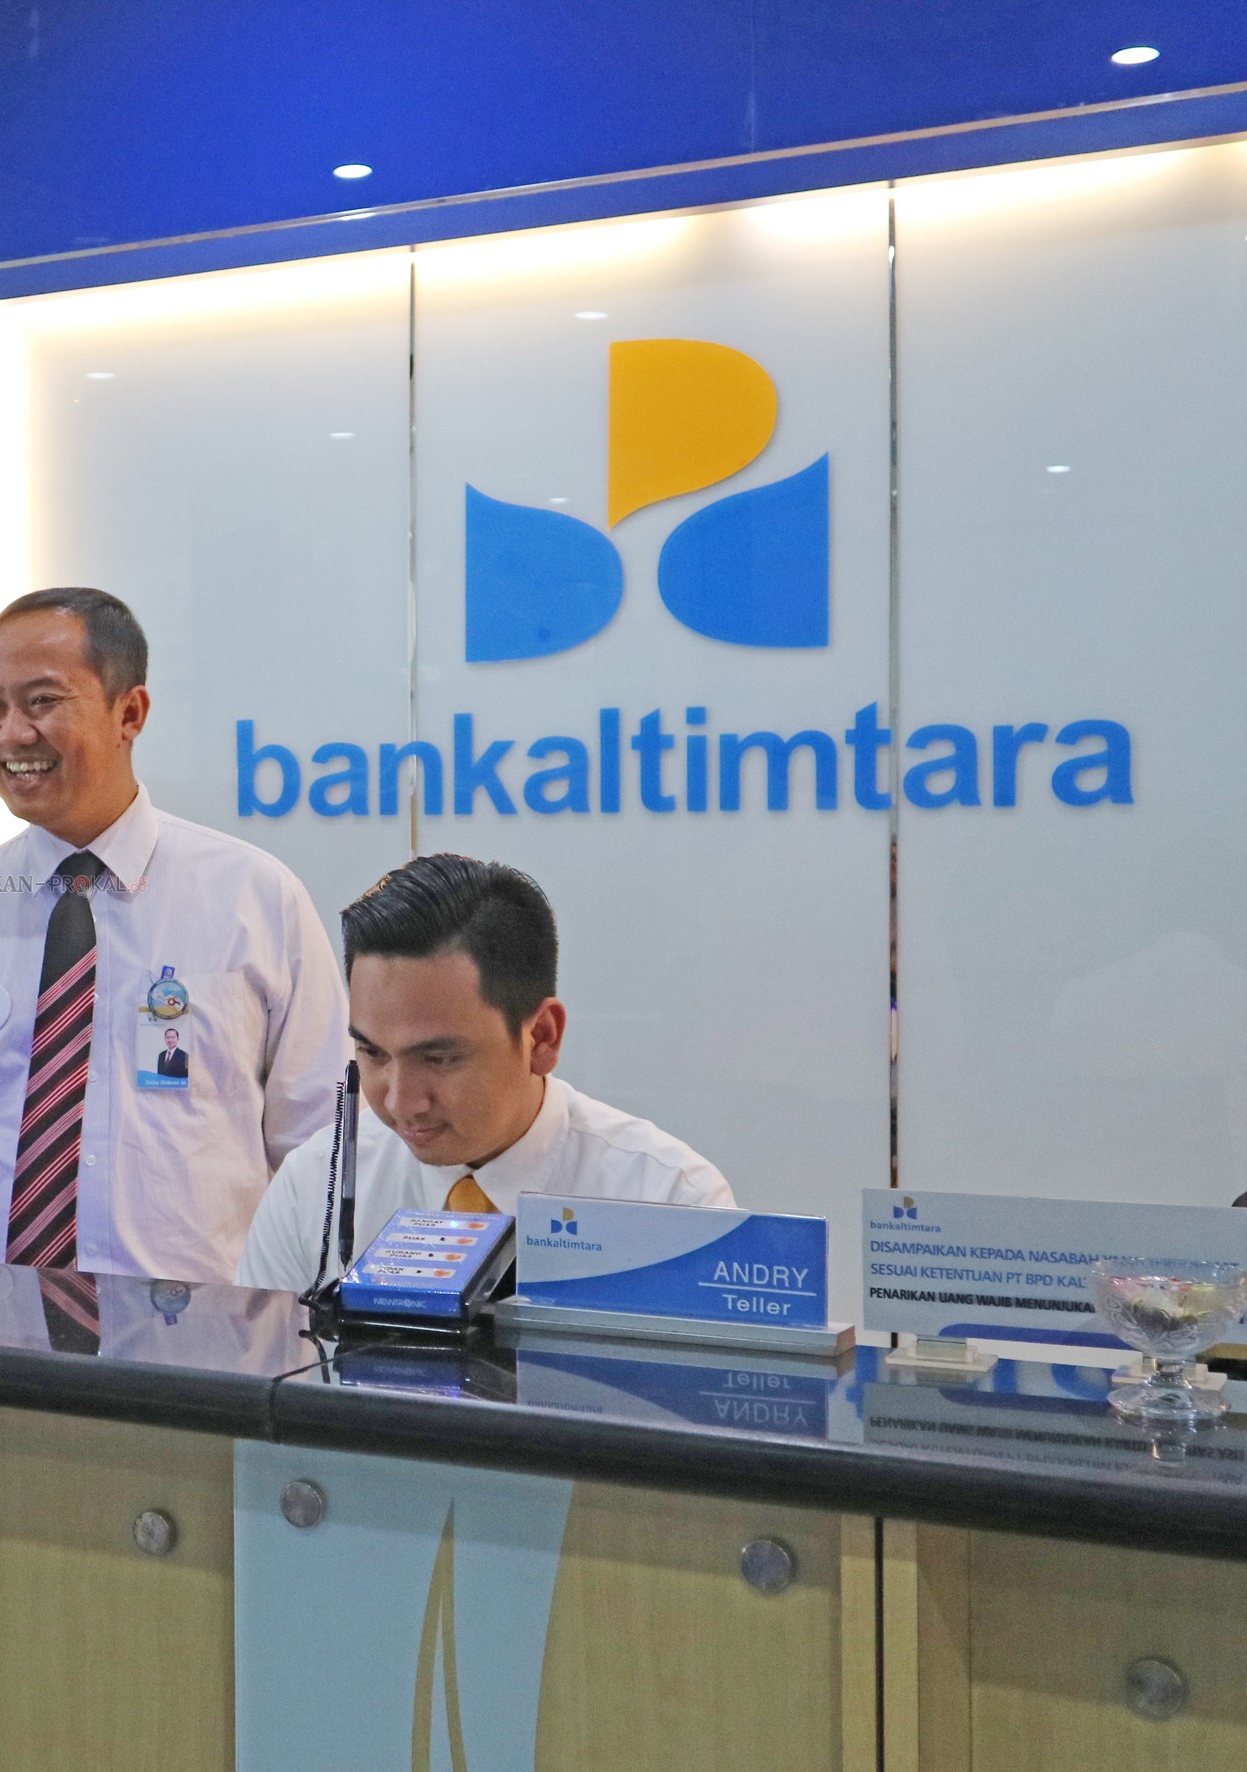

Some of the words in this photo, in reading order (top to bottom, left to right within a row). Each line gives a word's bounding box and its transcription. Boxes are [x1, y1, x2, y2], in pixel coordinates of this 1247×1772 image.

[234, 700, 1135, 819] bankaltimtara
[870, 1221, 941, 1233] bankaltimtara
[526, 1235, 602, 1252] bankaltimtara
[870, 1240, 967, 1258] DISAMPAIKAN
[970, 1247, 1025, 1262] KEPADA
[1029, 1250, 1099, 1266] NASABAH
[713, 1260, 809, 1289] ANDRY
[870, 1263, 917, 1277] SESUAI
[921, 1266, 1003, 1284] KETENTUAN
[1006, 1272, 1022, 1284] PT
[1026, 1274, 1053, 1287] BPD
[1057, 1275, 1087, 1289] KAL
[722, 1293, 792, 1316] Teller
[870, 1287, 936, 1303] PENARIKAN
[939, 1292, 973, 1306] UANG
[976, 1294, 1012, 1308] WAJIB
